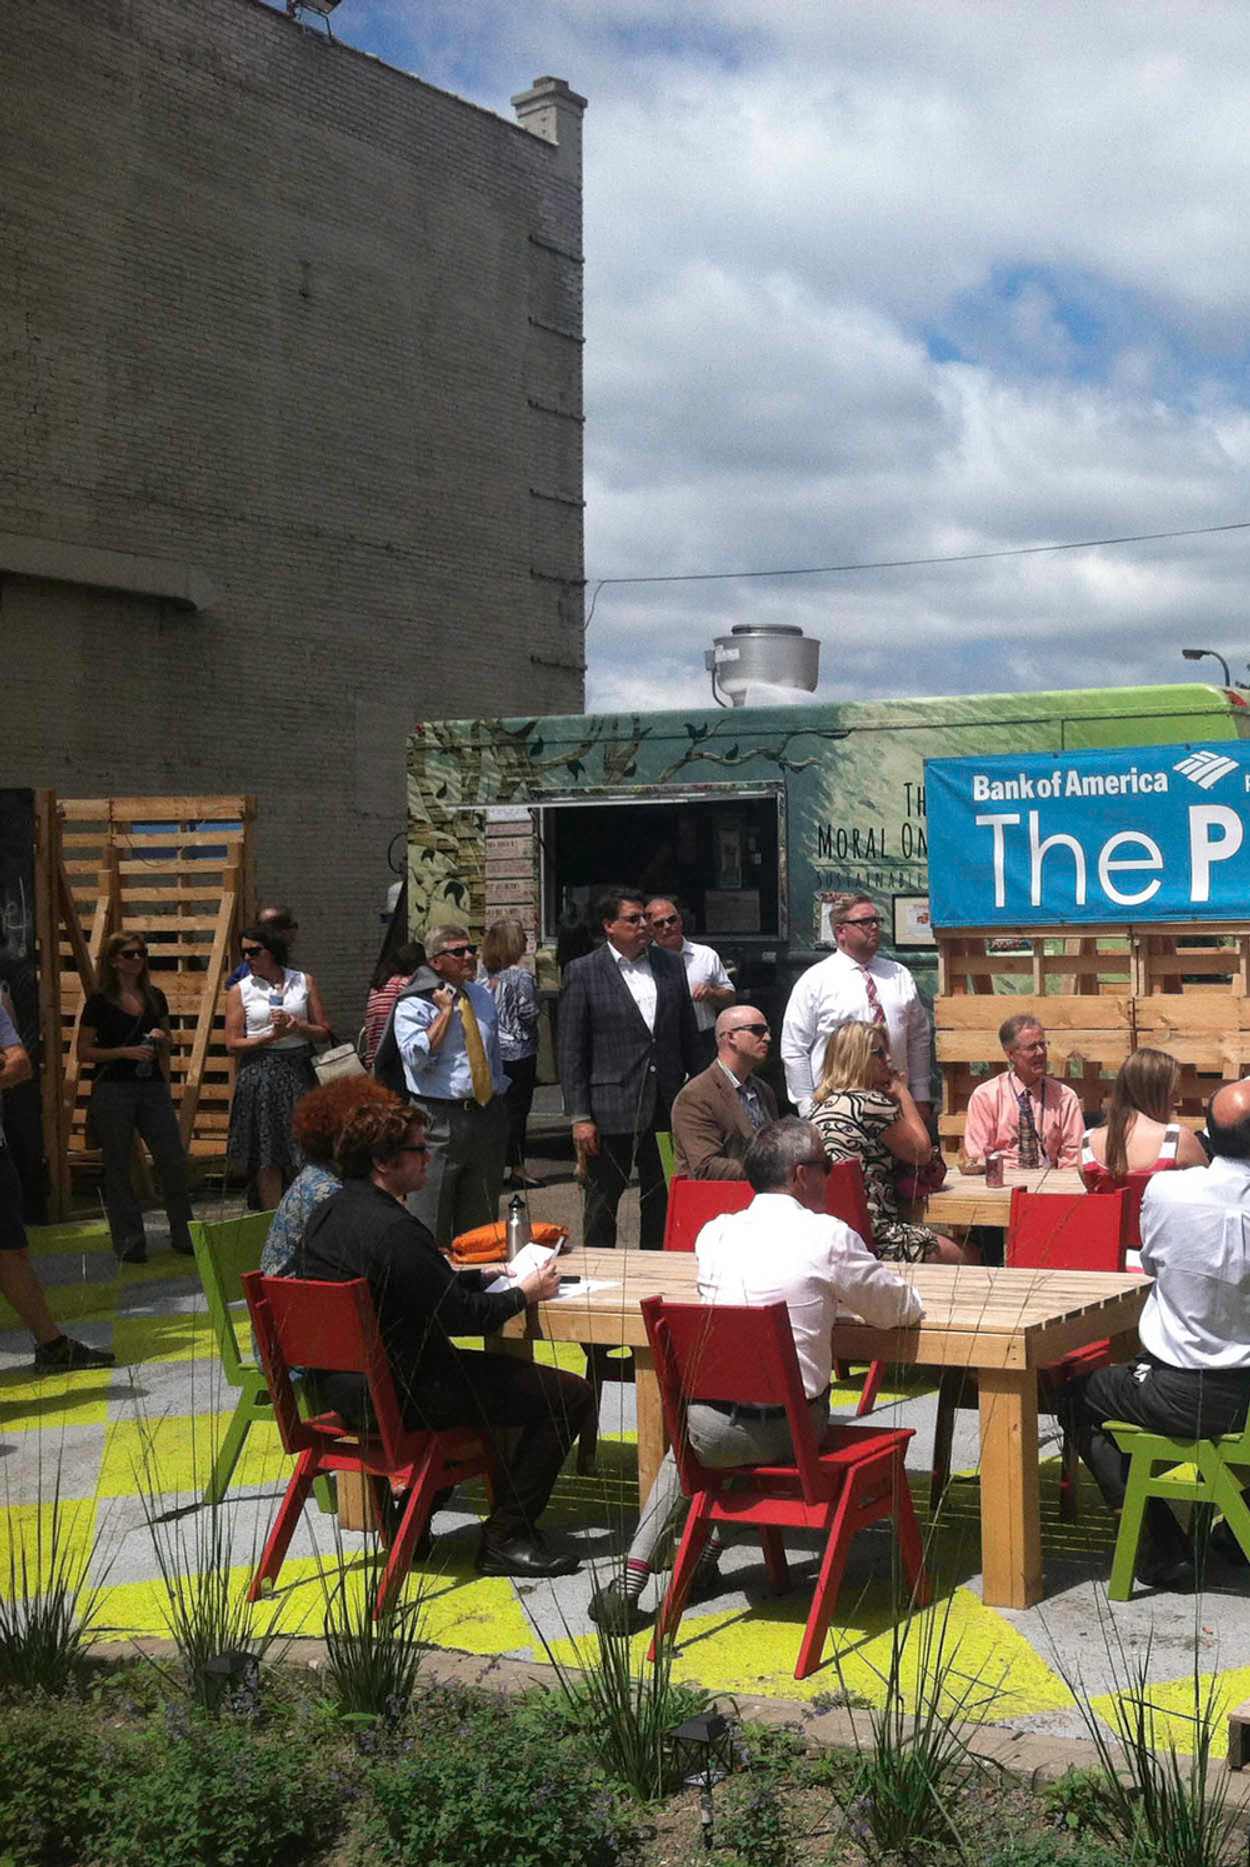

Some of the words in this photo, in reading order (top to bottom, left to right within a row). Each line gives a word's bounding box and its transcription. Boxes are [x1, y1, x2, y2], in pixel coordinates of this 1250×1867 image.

[973, 773, 1033, 802] Bank
[1036, 770, 1063, 798] of
[1065, 767, 1169, 797] America
[818, 824, 889, 860] MORAL
[975, 809, 1164, 909] The
